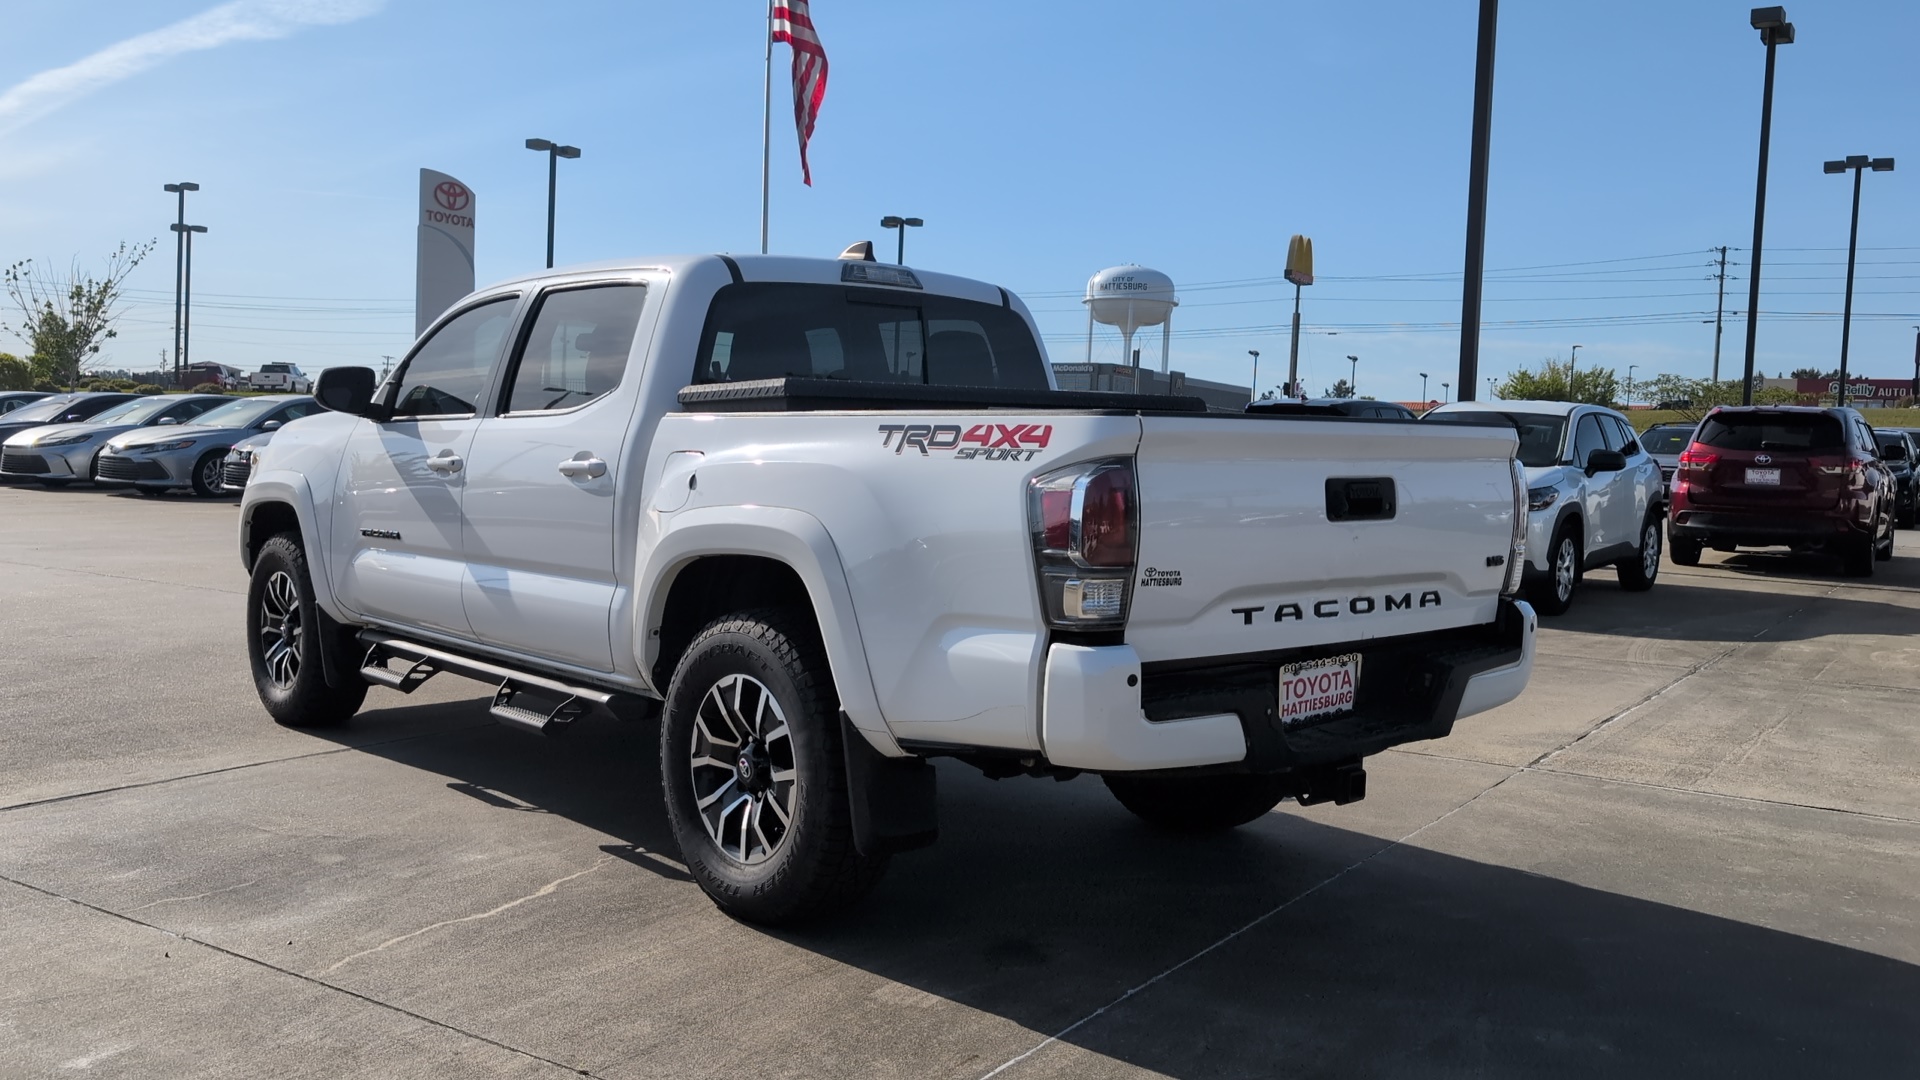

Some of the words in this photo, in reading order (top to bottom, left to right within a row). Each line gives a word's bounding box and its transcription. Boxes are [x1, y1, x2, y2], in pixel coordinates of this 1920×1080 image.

[425, 209, 475, 229] TOYOTA
[1100, 282, 1148, 291] HATTIESBURG
[1053, 364, 1094, 373] McDonald's
[1828, 380, 1876, 397] OReilly
[1877, 387, 1906, 397] AUTO
[954, 447, 1043, 462] SPORT
[1141, 577, 1182, 587] HATTIESBURG
[1231, 590, 1442, 625] TACOMA
[1282, 669, 1353, 701] TOYOTA
[1281, 690, 1353, 718] HATTIESBURG
